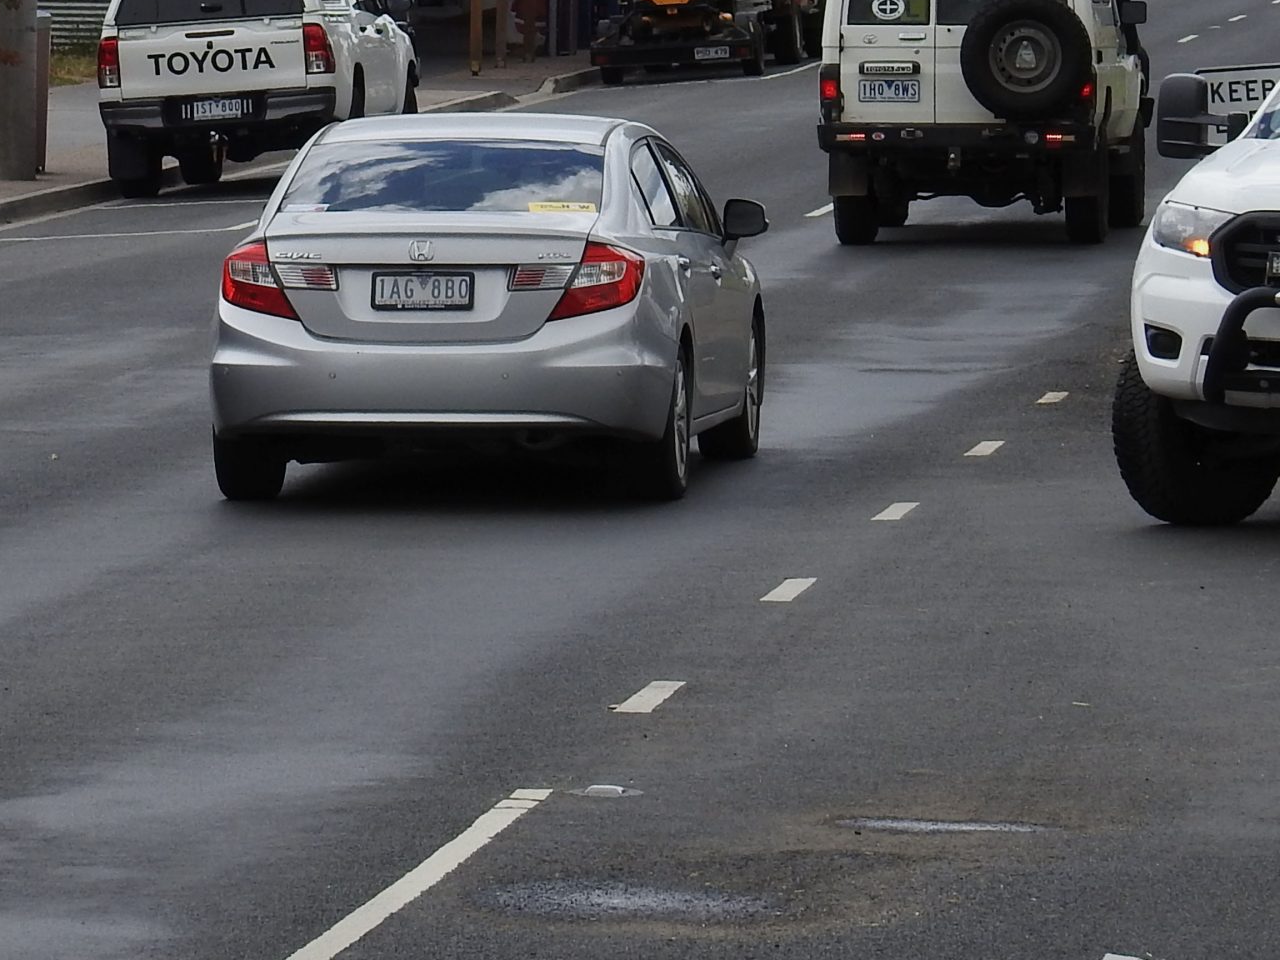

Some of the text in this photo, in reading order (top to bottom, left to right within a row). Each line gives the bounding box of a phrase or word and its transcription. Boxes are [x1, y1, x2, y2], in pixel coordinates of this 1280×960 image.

[147, 47, 276, 76] TOYOTA
[1210, 79, 1276, 104] KEEP
[379, 278, 415, 299] 1AG
